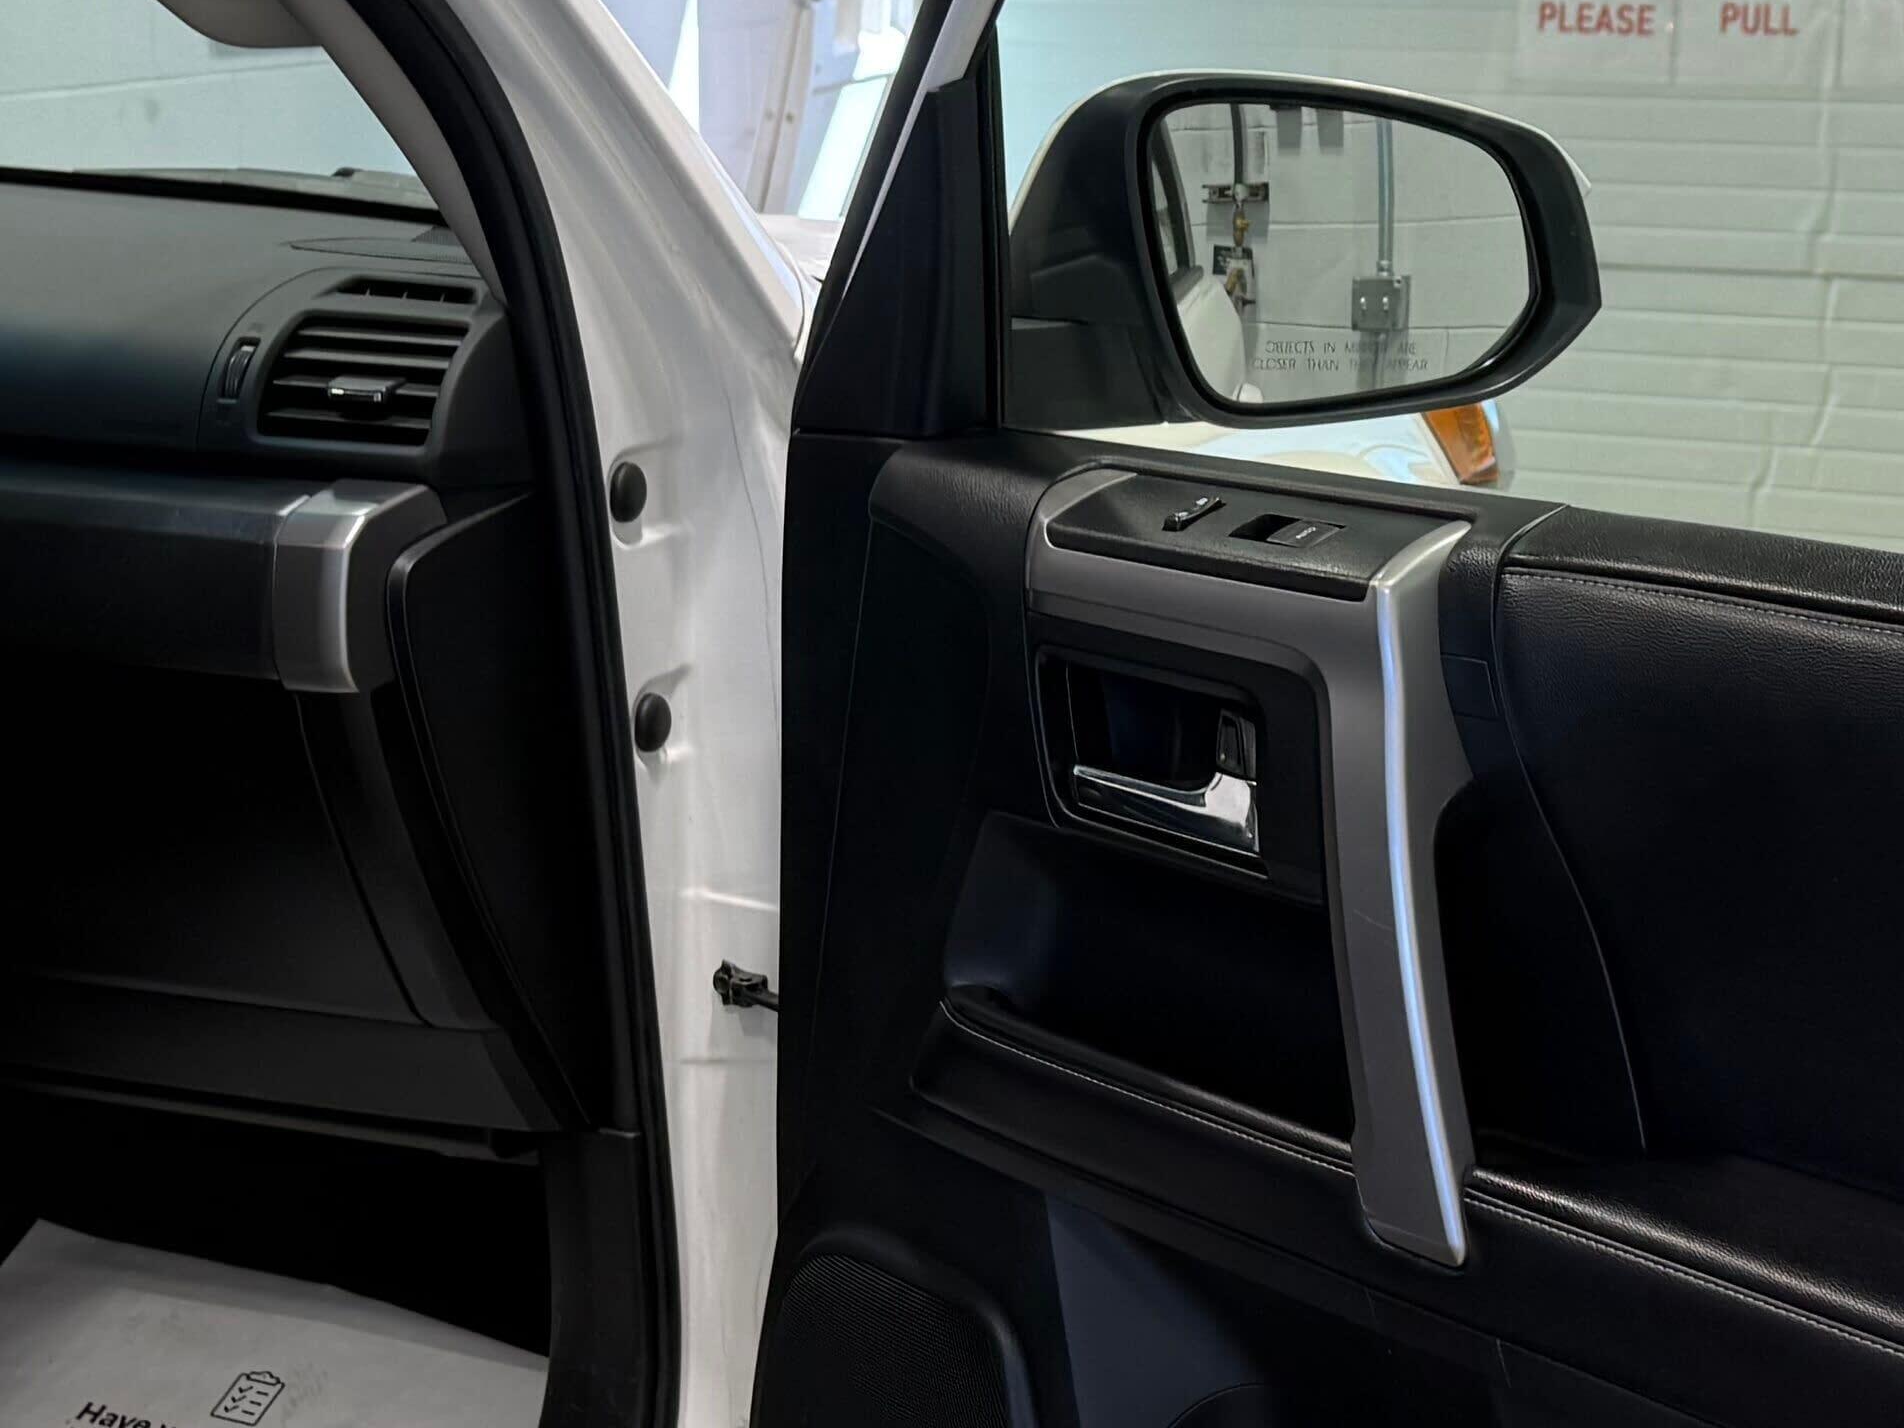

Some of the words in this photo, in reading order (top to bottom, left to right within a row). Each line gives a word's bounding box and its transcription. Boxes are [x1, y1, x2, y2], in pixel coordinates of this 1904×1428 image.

[1537, 1, 1656, 37] PLEASE
[1719, 2, 1798, 38] PULL
[1265, 340, 1315, 355] OBJECTS
[1324, 341, 1337, 354] IN
[1252, 357, 1296, 372] CLOSER
[1307, 357, 1339, 372] THAN
